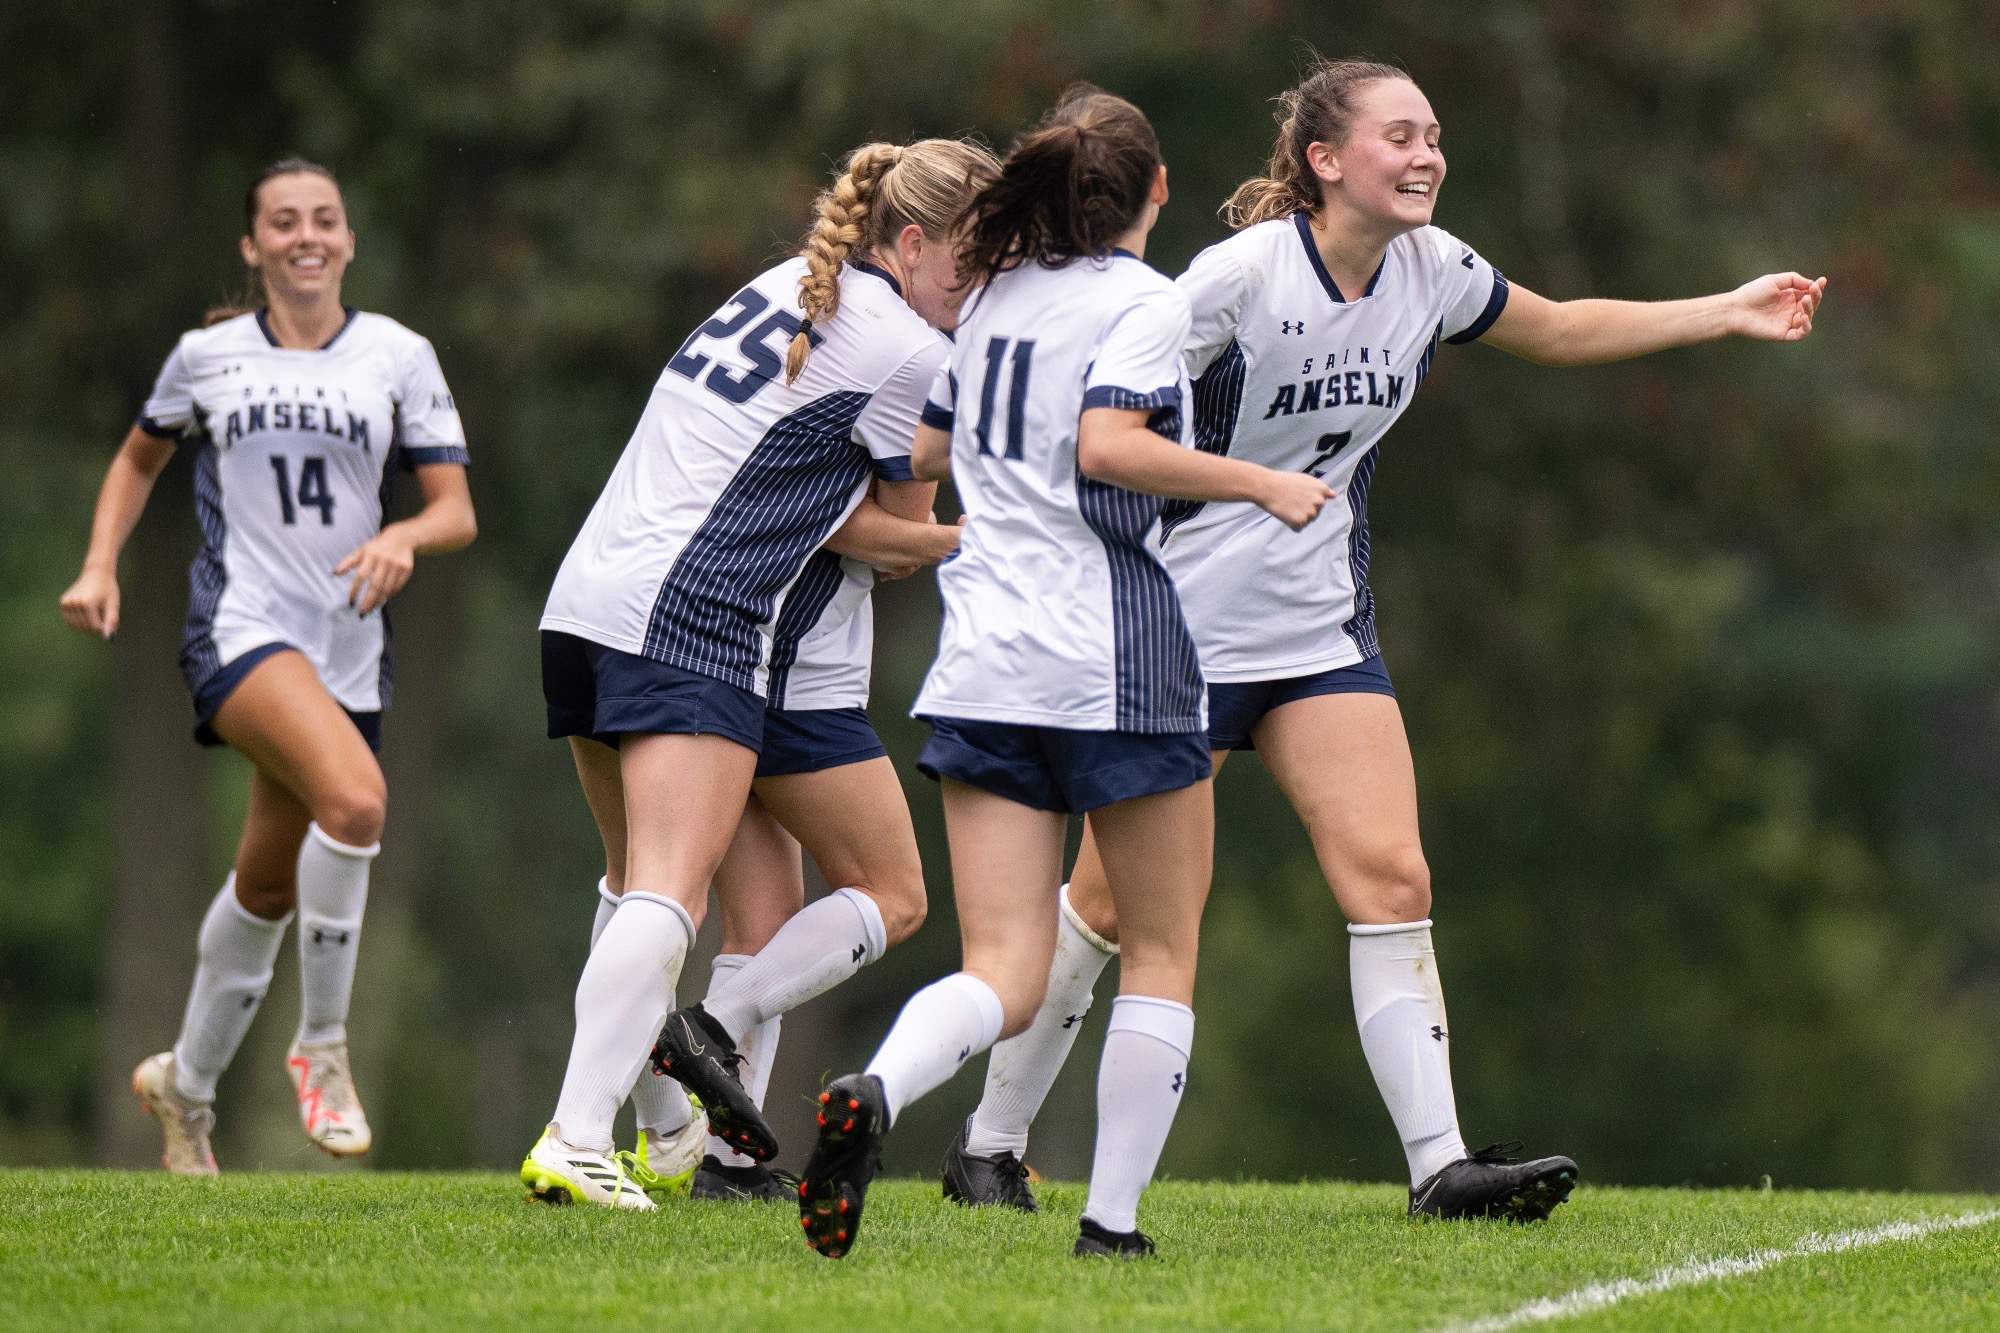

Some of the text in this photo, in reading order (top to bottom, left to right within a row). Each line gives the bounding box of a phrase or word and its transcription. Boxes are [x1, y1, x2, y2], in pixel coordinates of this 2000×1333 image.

[665, 286, 827, 406] 25
[1302, 347, 1390, 374] SAINT
[975, 334, 1038, 461] 11
[1263, 371, 1404, 420] ANSELM
[226, 402, 370, 450] ANSELM
[270, 456, 336, 525] 14
